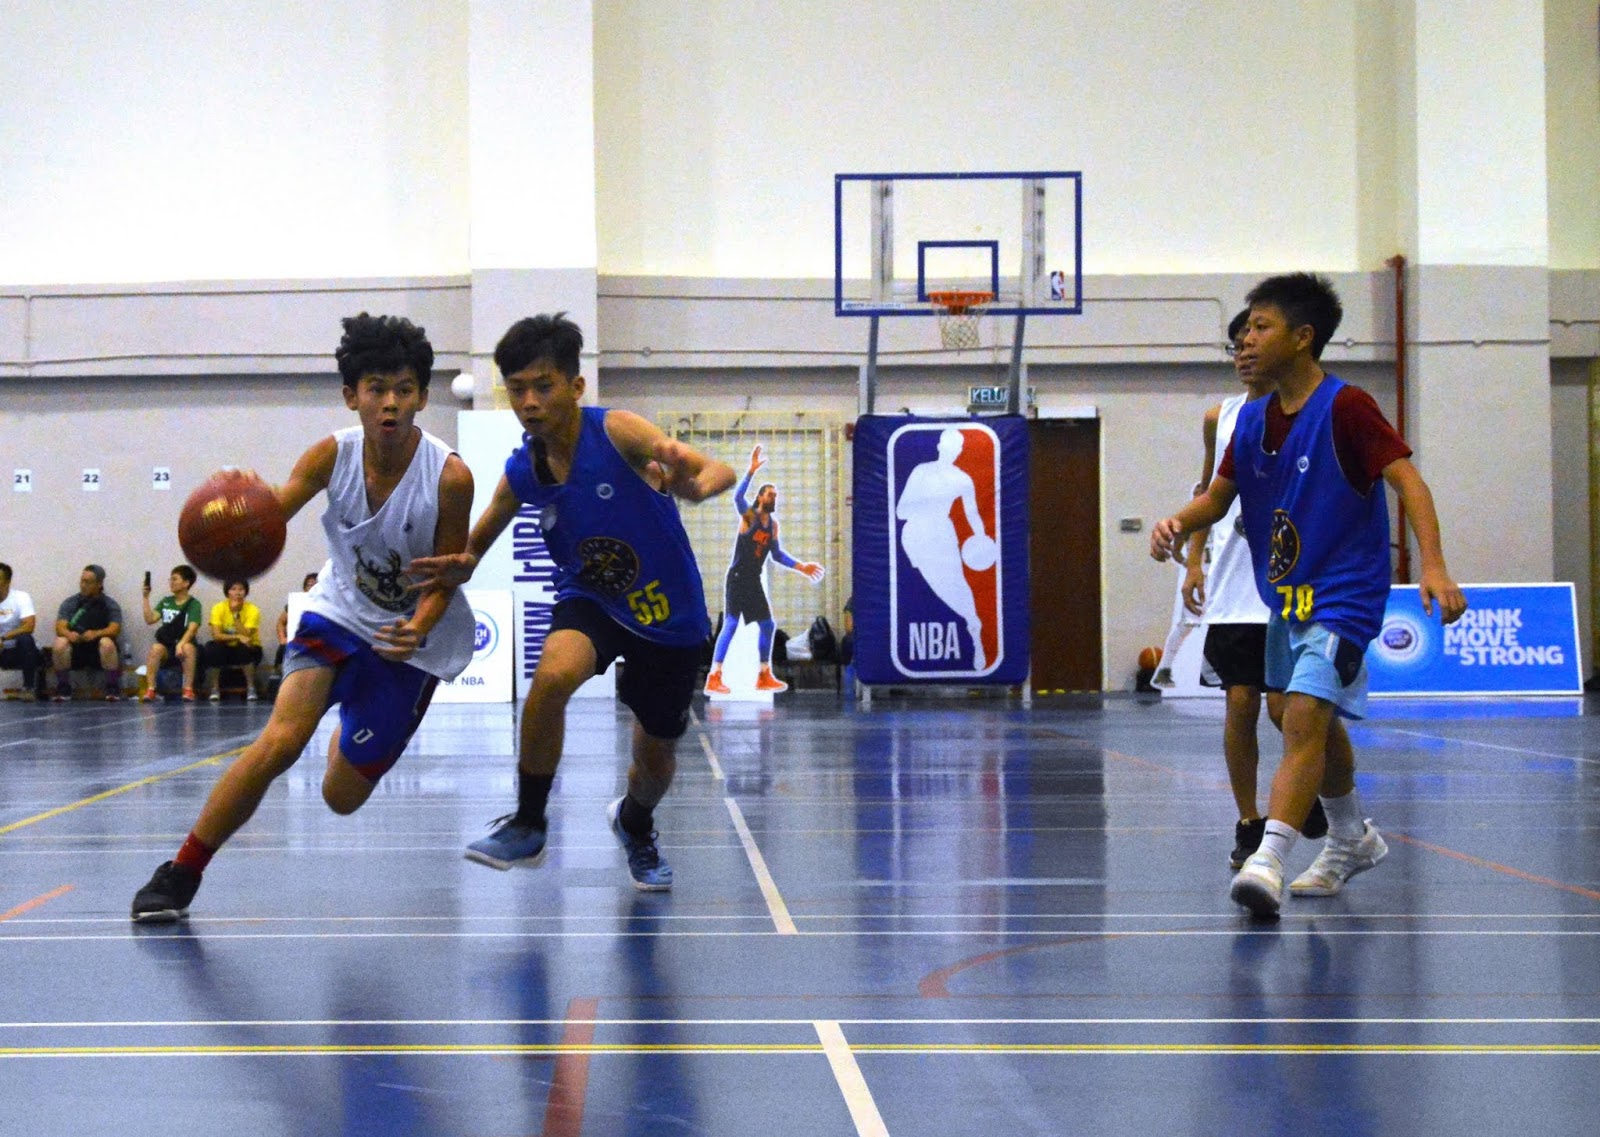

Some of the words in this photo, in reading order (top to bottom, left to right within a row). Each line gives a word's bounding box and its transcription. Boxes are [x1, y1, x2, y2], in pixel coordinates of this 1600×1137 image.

[15, 474, 30, 483] 21
[83, 474, 99, 483] 22
[154, 472, 170, 481] 23
[627, 579, 670, 625] 55
[1444, 608, 1522, 628] RINK
[908, 621, 961, 660] NBA
[1444, 627, 1519, 647] MOVE
[1459, 645, 1564, 666] STRONG
[461, 676, 485, 686] NBA
